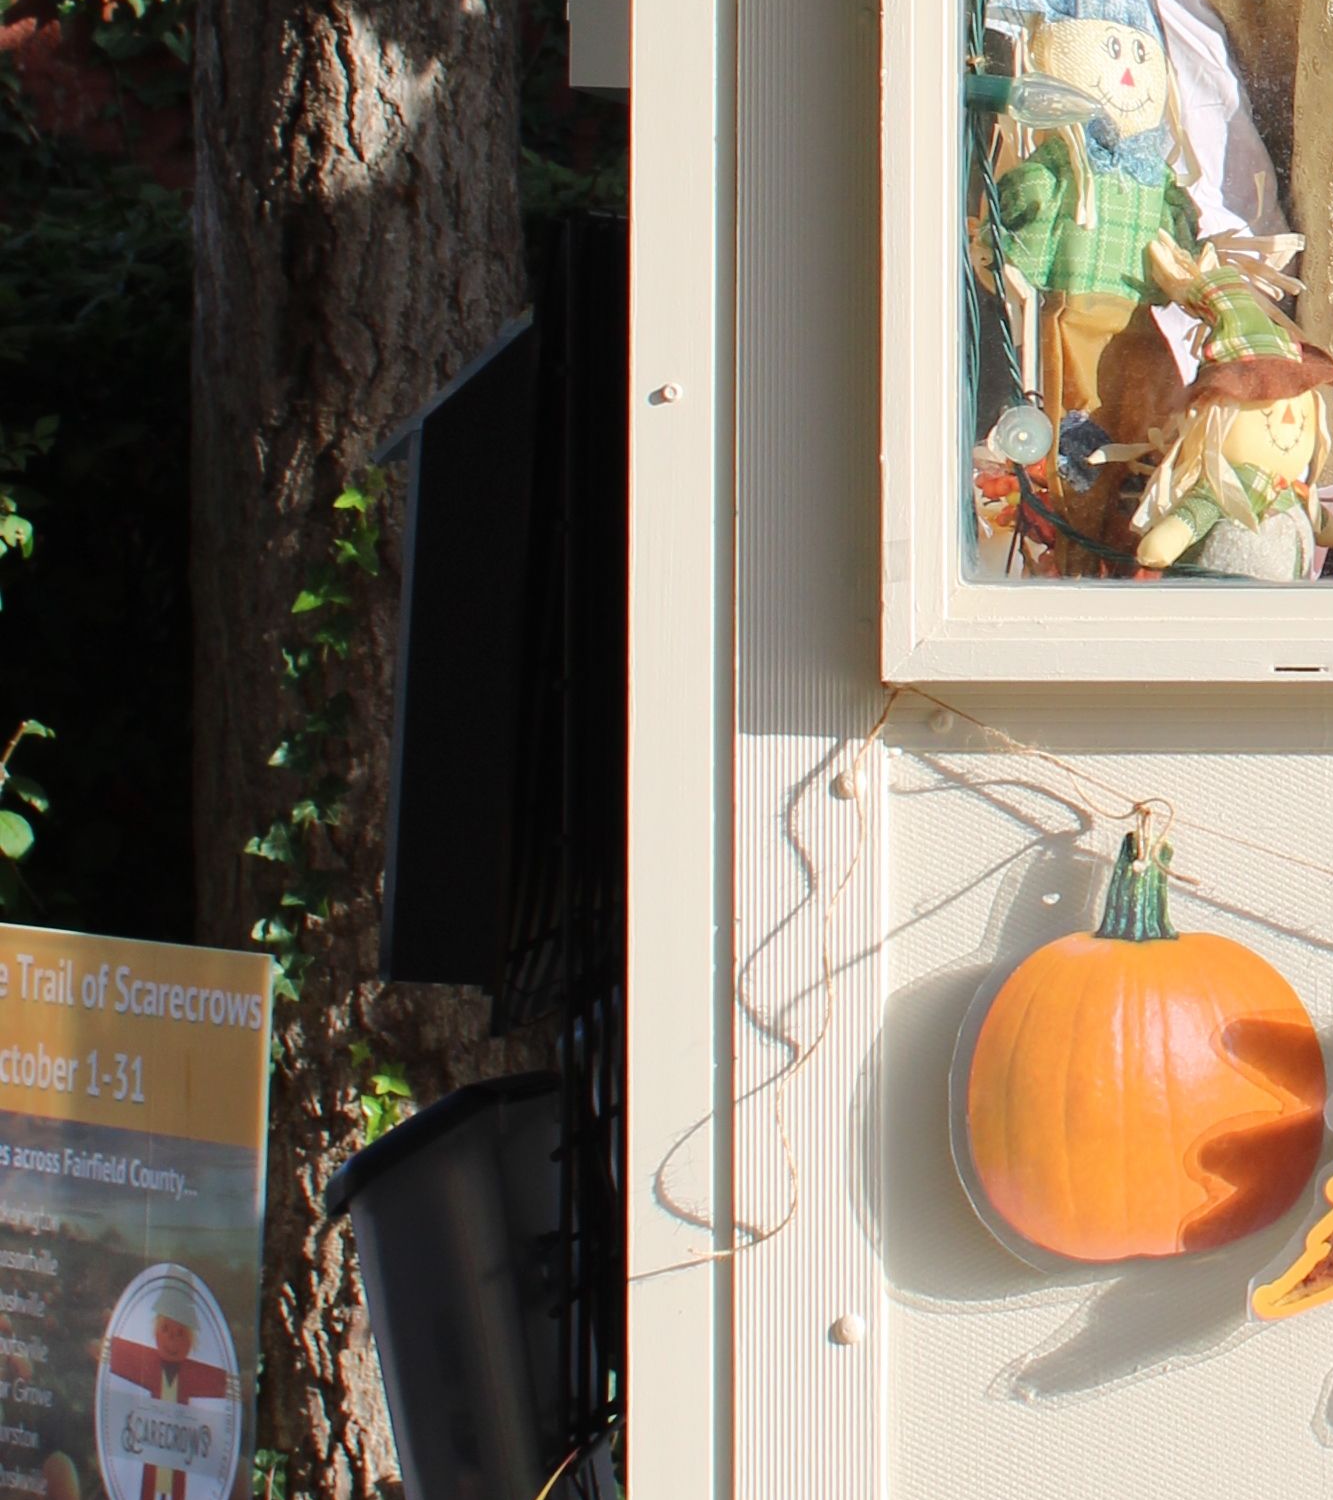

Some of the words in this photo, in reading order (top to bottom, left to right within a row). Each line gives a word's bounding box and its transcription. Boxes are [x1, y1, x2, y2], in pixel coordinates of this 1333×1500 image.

[16, 953, 74, 1007] Trail
[82, 963, 111, 1011] of
[114, 965, 263, 1031] Scarecrows
[0, 1042, 79, 1093] ctober
[86, 1049, 145, 1105] 1-31
[14, 1147, 60, 1175] across
[63, 1147, 127, 1185] Fairfield
[129, 1157, 199, 1201] County...
[120, 1408, 213, 1466] SCARECROWS
